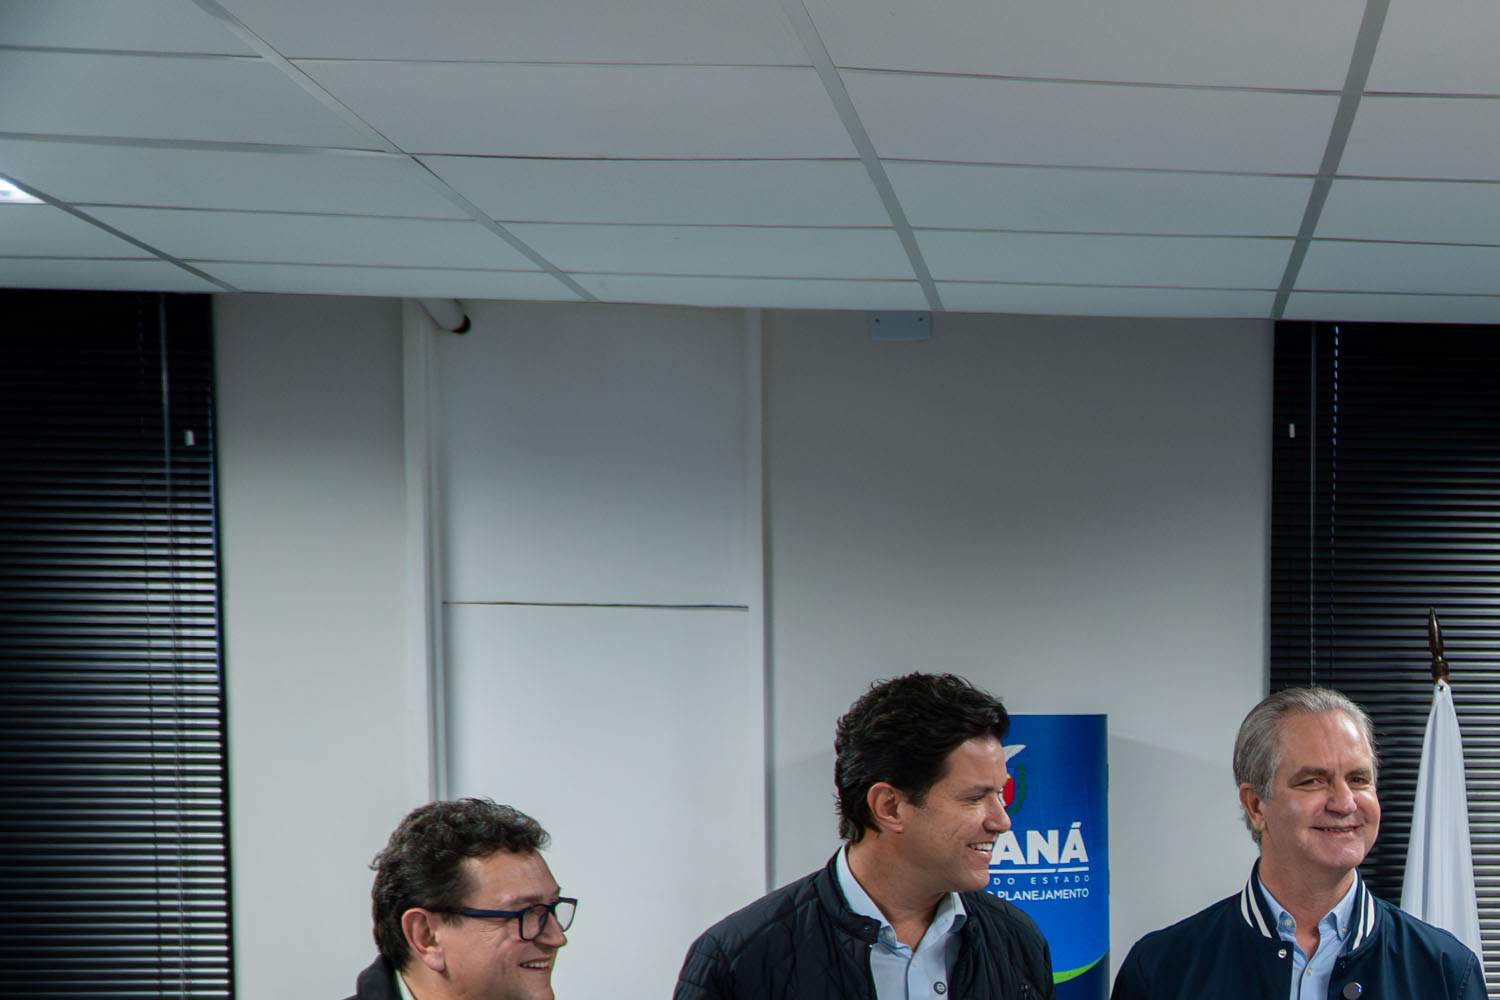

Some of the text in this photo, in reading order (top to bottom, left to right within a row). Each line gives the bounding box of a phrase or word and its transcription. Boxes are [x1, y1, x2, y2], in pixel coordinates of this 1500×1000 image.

[991, 822, 1089, 866] ANÁ
[993, 874, 1090, 886] DO ESTADO
[997, 888, 1090, 901] PLANEJAMENTO
